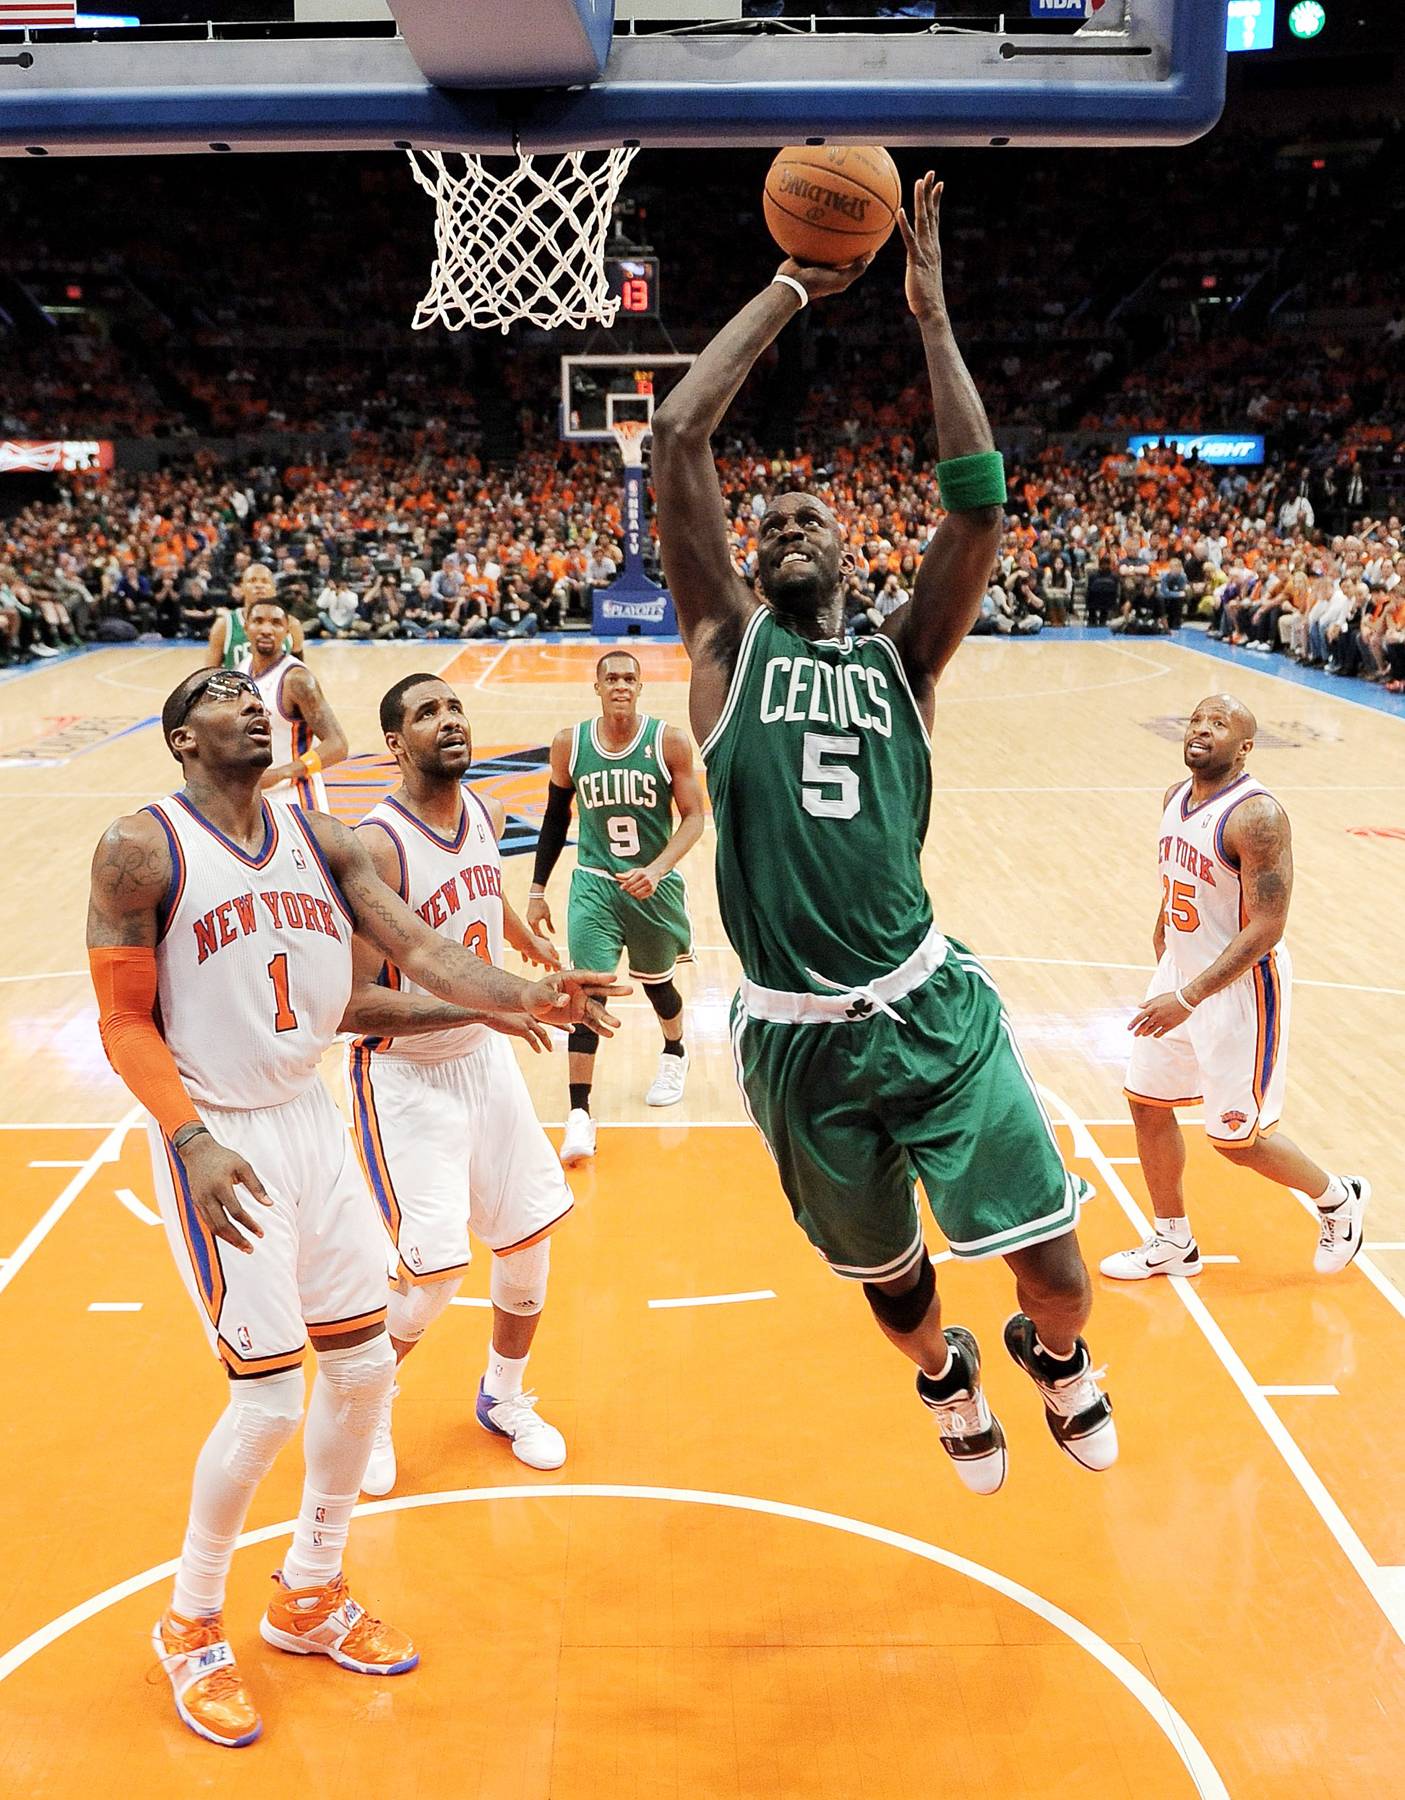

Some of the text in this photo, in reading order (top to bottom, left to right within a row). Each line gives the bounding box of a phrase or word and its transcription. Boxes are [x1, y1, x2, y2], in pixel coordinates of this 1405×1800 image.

[779, 168, 871, 223] SPALDING
[622, 279, 648, 311] 13
[759, 656, 893, 739] CELTICS
[578, 768, 658, 810] CELTICS
[802, 731, 861, 820] 5
[607, 815, 641, 857] 9
[1176, 836, 1217, 888] YORK
[192, 893, 257, 966] NEW
[260, 891, 343, 945] YORK
[267, 952, 299, 1033] 1
